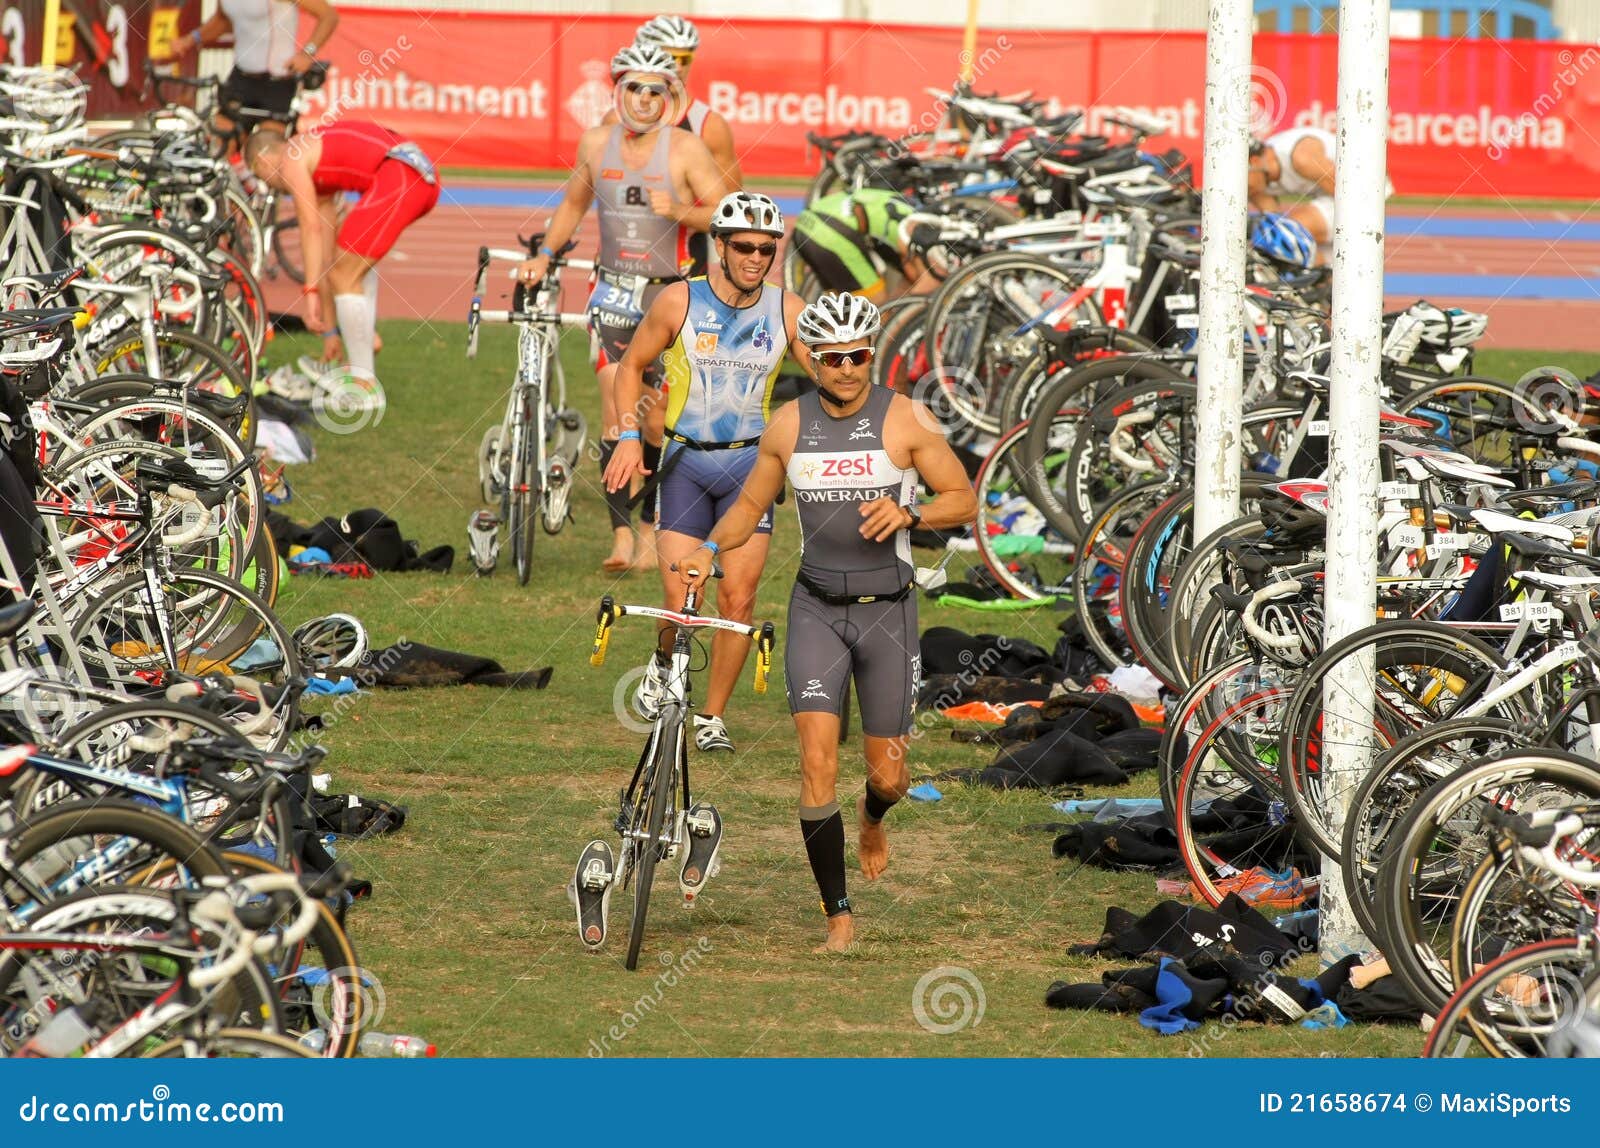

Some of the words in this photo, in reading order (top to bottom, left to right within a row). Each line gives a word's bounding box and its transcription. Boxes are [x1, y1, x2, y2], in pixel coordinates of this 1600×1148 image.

[105, 4, 129, 88] 3
[708, 81, 911, 128] Barcelona
[1385, 105, 1564, 148] arcelona
[695, 358, 769, 372] SPARTRIANS
[822, 453, 874, 476] zest
[1391, 487, 1407, 495] 386
[1400, 535, 1415, 544] 385
[1439, 537, 1455, 545] 384
[1505, 607, 1521, 616] 381
[1530, 606, 1548, 615] 380
[1559, 646, 1575, 657] 379
[911, 653, 921, 697] zest
